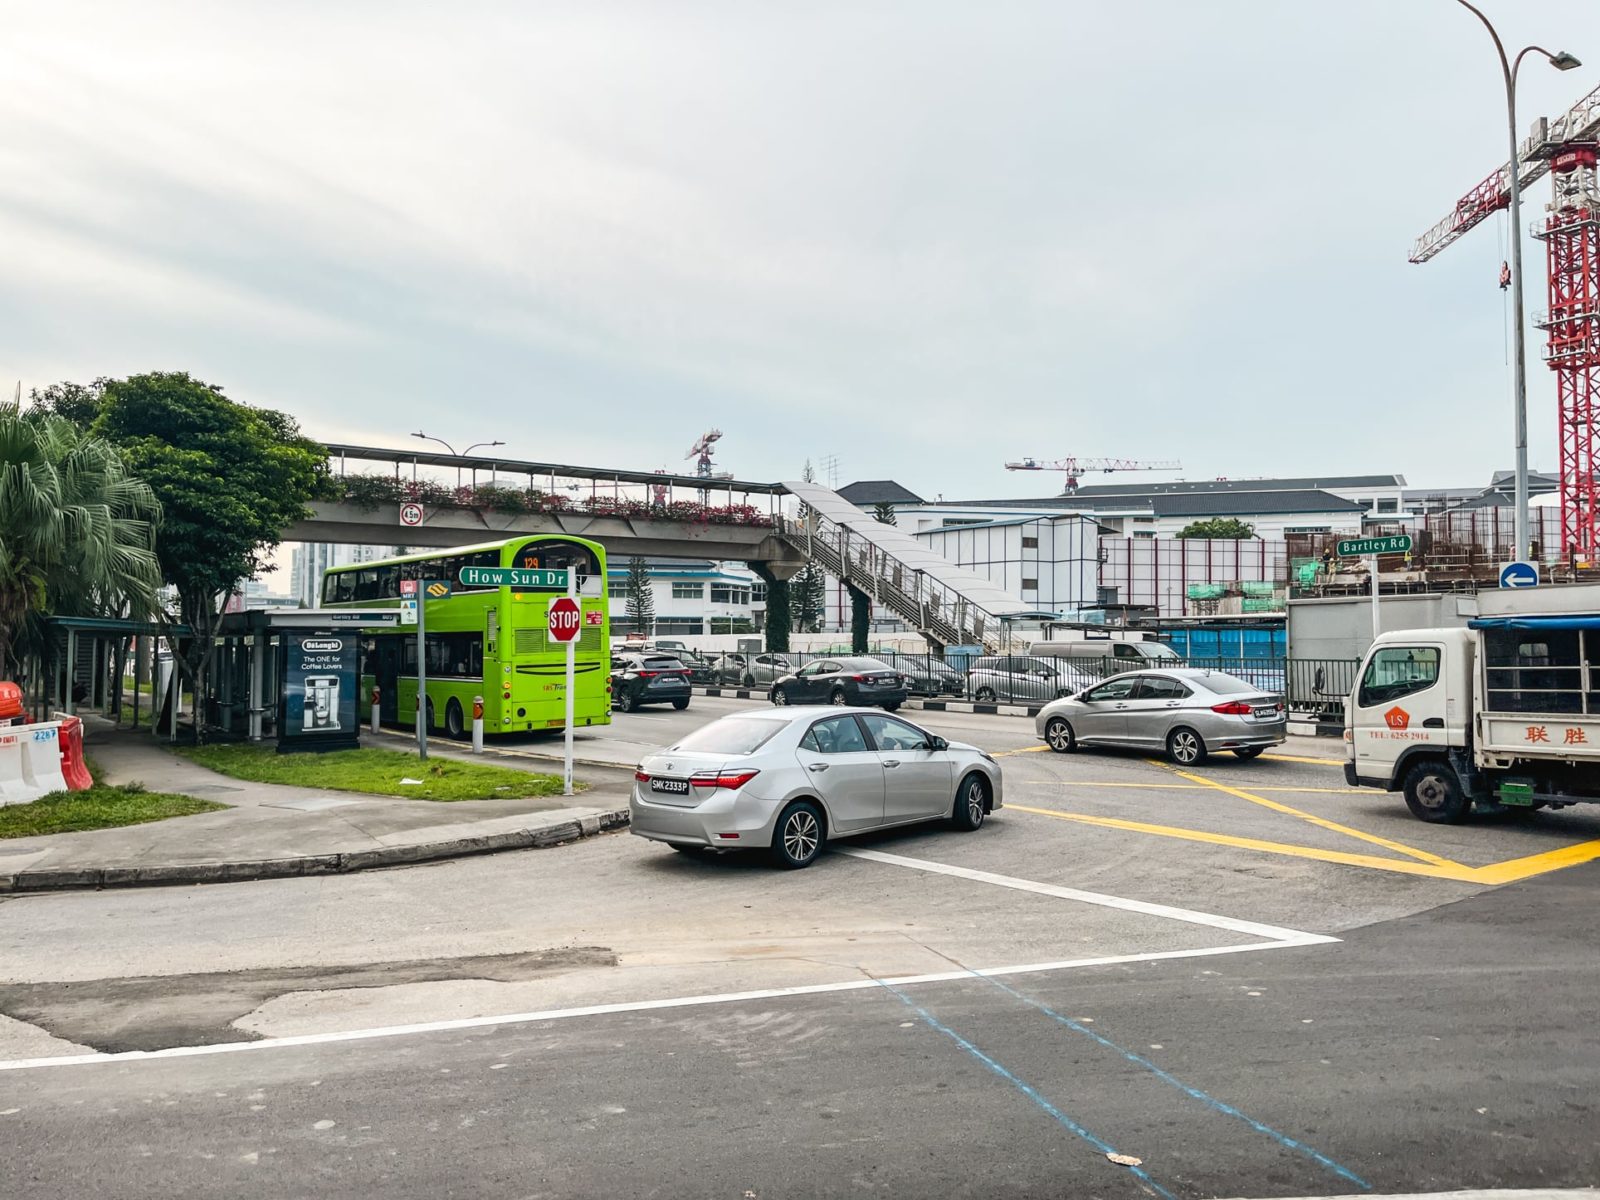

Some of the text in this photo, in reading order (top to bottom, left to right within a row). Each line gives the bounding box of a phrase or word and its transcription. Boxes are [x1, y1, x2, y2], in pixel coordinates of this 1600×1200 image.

[1343, 538, 1405, 552] Bartley Rd
[524, 557, 539, 569] 129
[469, 570, 564, 585] How Sun Dr
[550, 611, 580, 629] STOP
[1390, 715, 1404, 726] LS
[34, 730, 56, 740] 2287
[1524, 725, 1588, 745] 联胜
